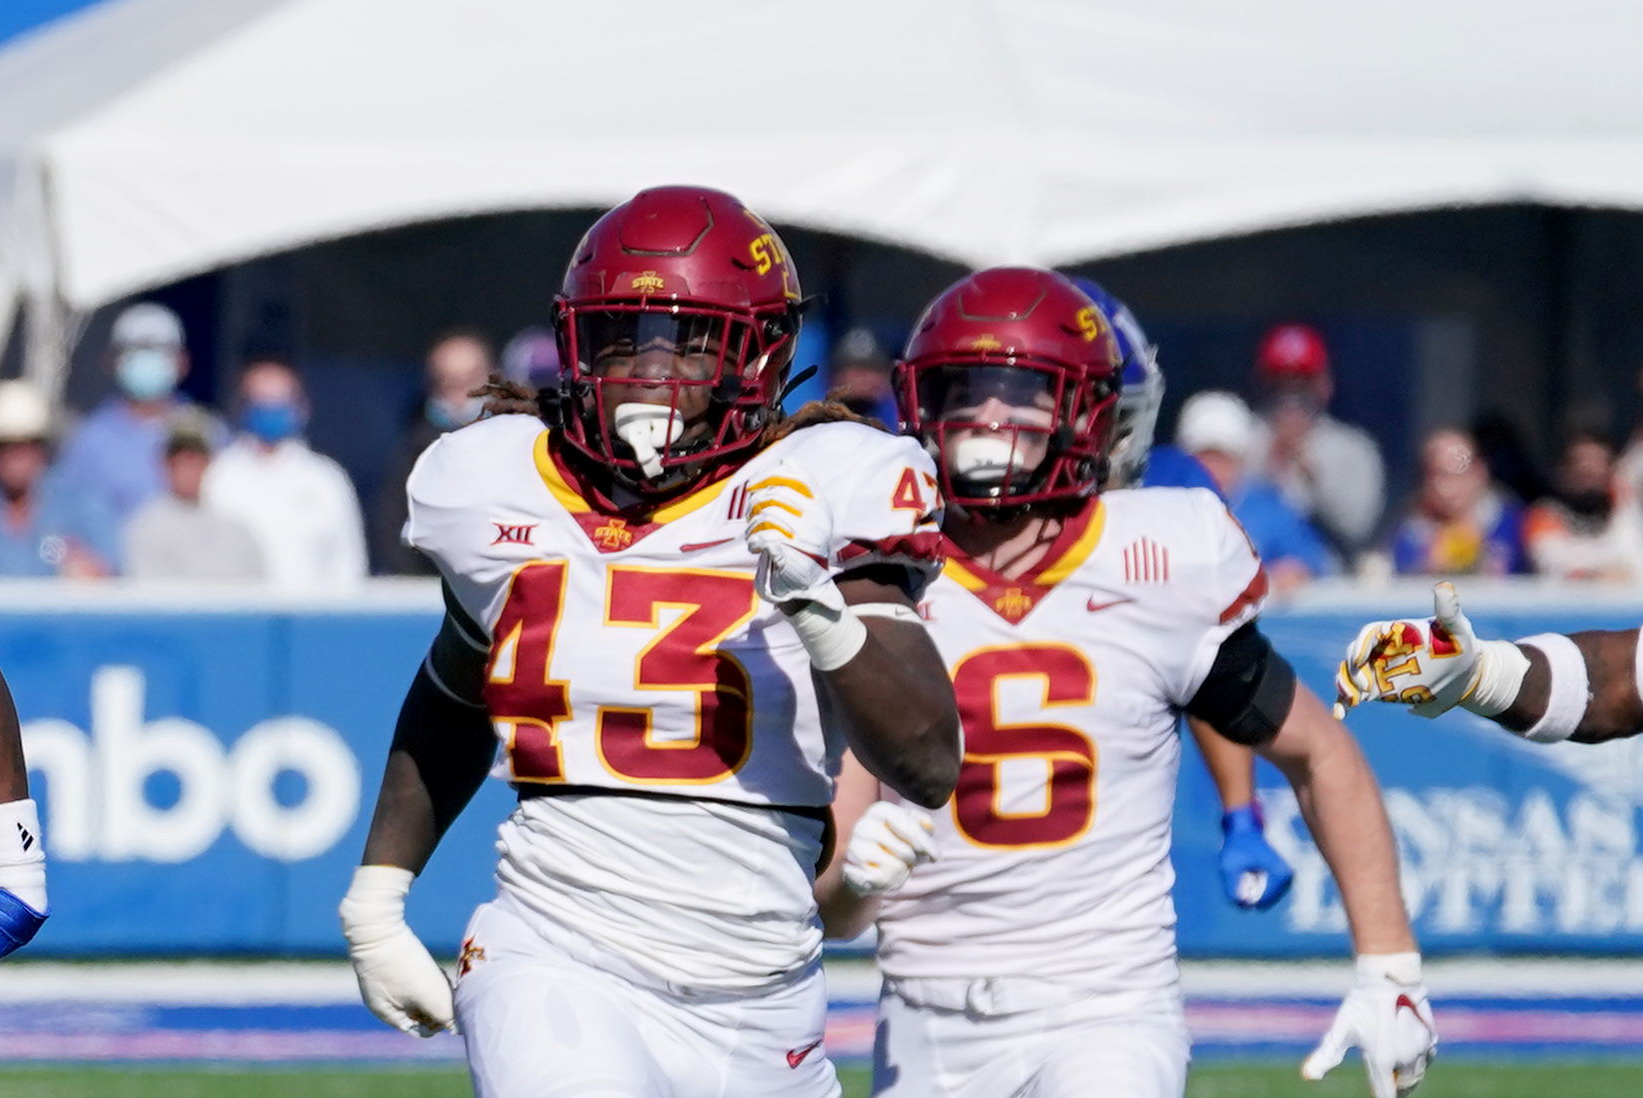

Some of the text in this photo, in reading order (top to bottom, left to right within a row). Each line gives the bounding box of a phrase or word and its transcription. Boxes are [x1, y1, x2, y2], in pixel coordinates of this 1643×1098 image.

[891, 467, 945, 533] 4
[483, 558, 761, 786] 43
[951, 642, 1098, 852] 6
